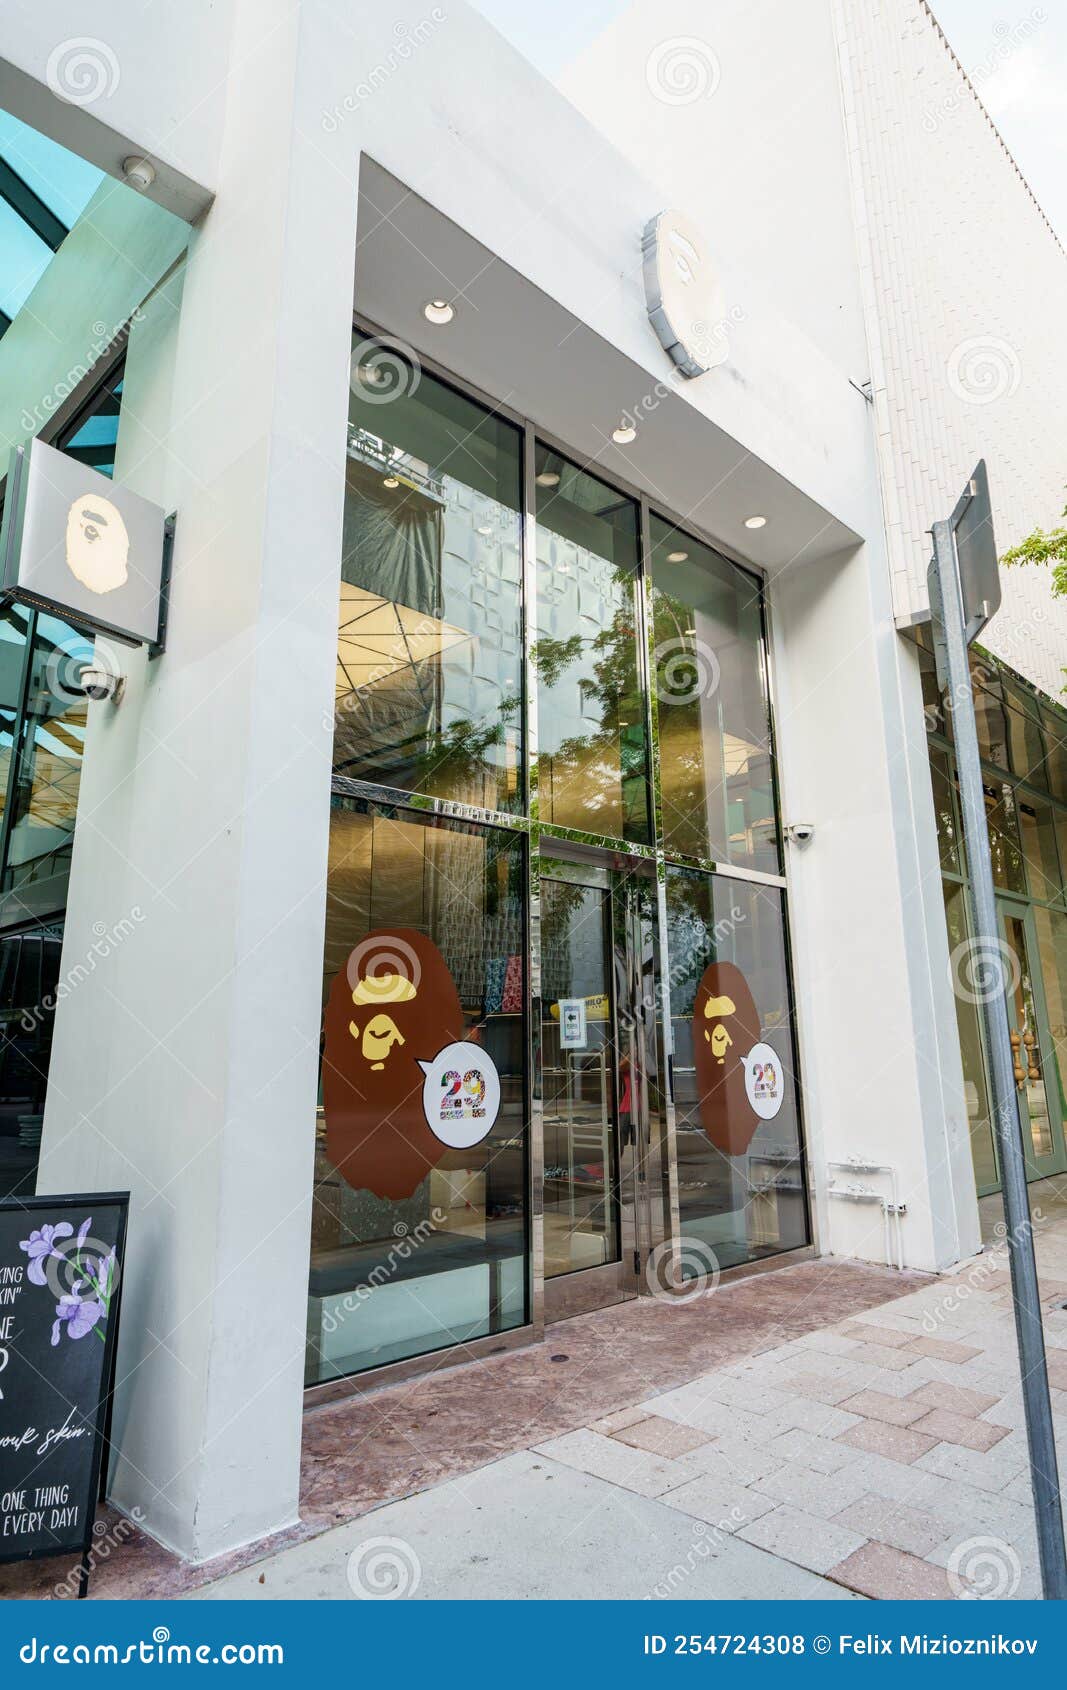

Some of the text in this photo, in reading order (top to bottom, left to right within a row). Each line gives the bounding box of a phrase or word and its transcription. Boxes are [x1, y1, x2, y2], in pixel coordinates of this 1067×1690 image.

[440, 1070, 486, 1109] 29
[753, 1063, 776, 1091] 29
[1, 1484, 69, 1512] ONE THING
[3, 1511, 45, 1536] EVERY
